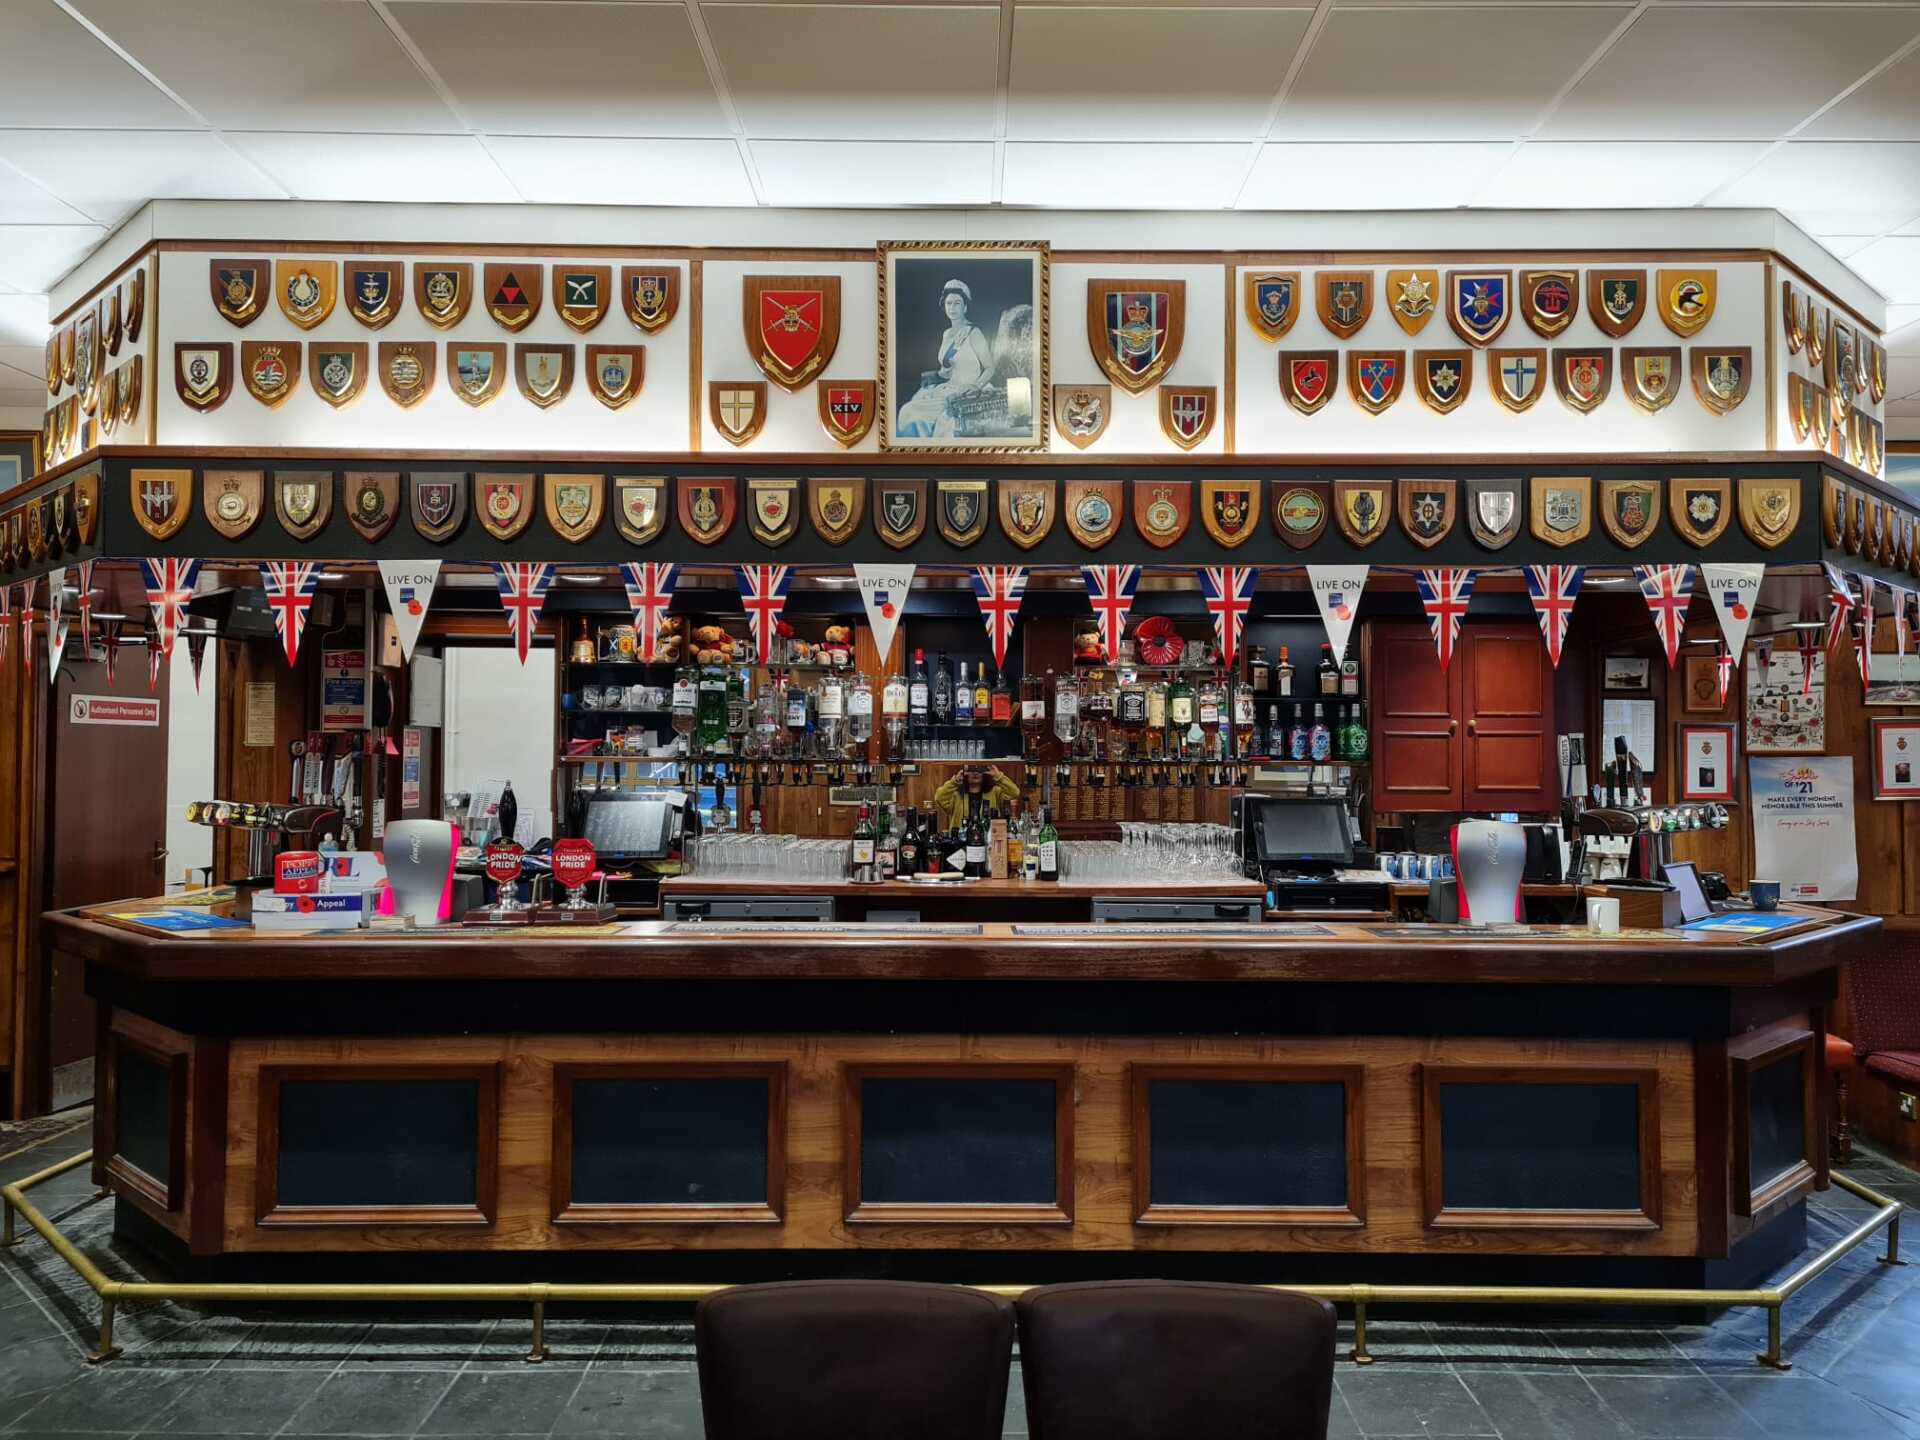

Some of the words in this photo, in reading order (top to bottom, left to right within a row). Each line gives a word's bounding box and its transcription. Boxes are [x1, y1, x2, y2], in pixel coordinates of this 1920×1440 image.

[833, 403, 860, 412] XIV
[388, 575, 410, 585] LIVE
[413, 575, 433, 585] ON
[862, 578, 885, 588] LIVE
[887, 578, 906, 588] ON
[1316, 580, 1339, 590] LIVE
[1342, 580, 1361, 590] ON
[1711, 578, 1734, 589] LIVE
[1737, 578, 1757, 589] ON
[486, 853, 521, 863] LONDON
[555, 854, 592, 862] LONDON
[490, 861, 516, 869] PRIDE
[317, 899, 346, 909] Appeal
